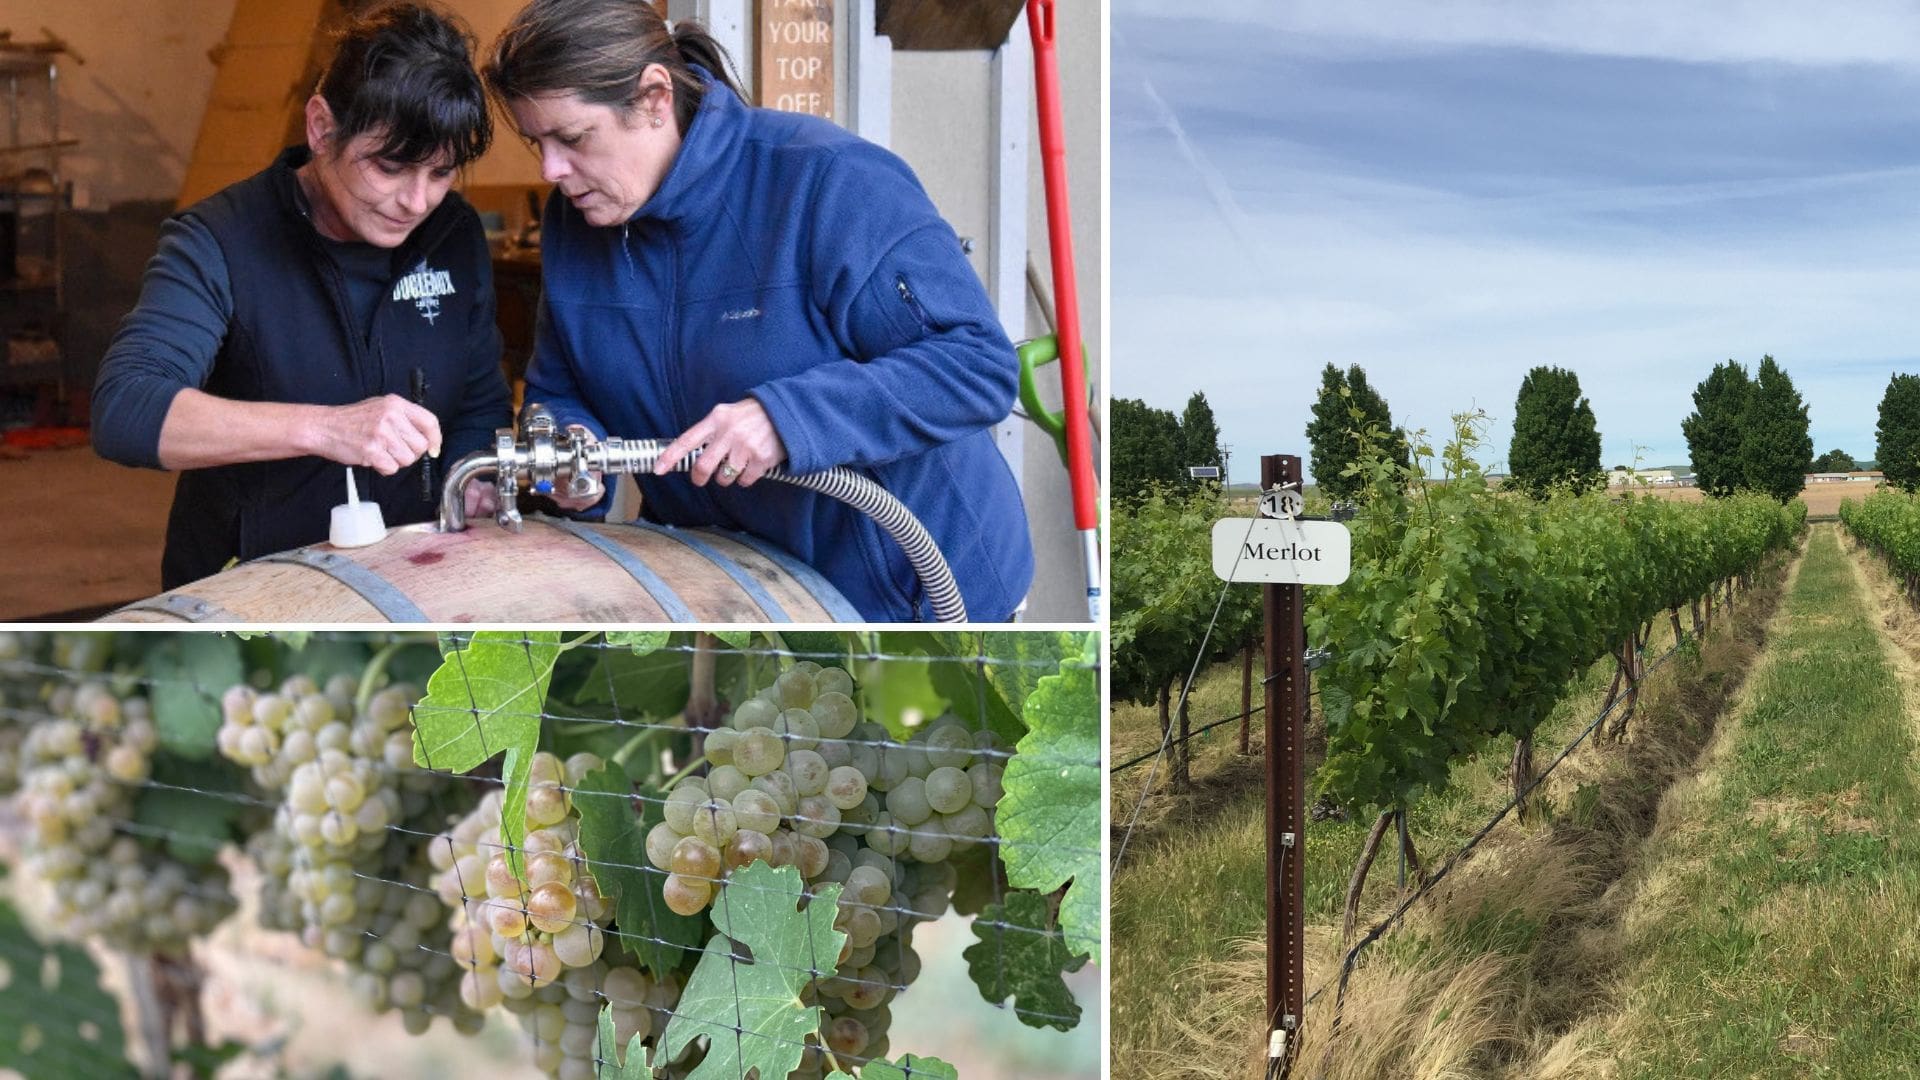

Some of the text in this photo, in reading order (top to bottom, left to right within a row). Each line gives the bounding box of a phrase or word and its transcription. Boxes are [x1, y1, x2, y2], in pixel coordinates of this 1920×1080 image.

[769, 21, 830, 43] YOUR
[776, 56, 822, 80] TOP
[1267, 496, 1294, 513] 18
[1243, 542, 1322, 562] Merlot
